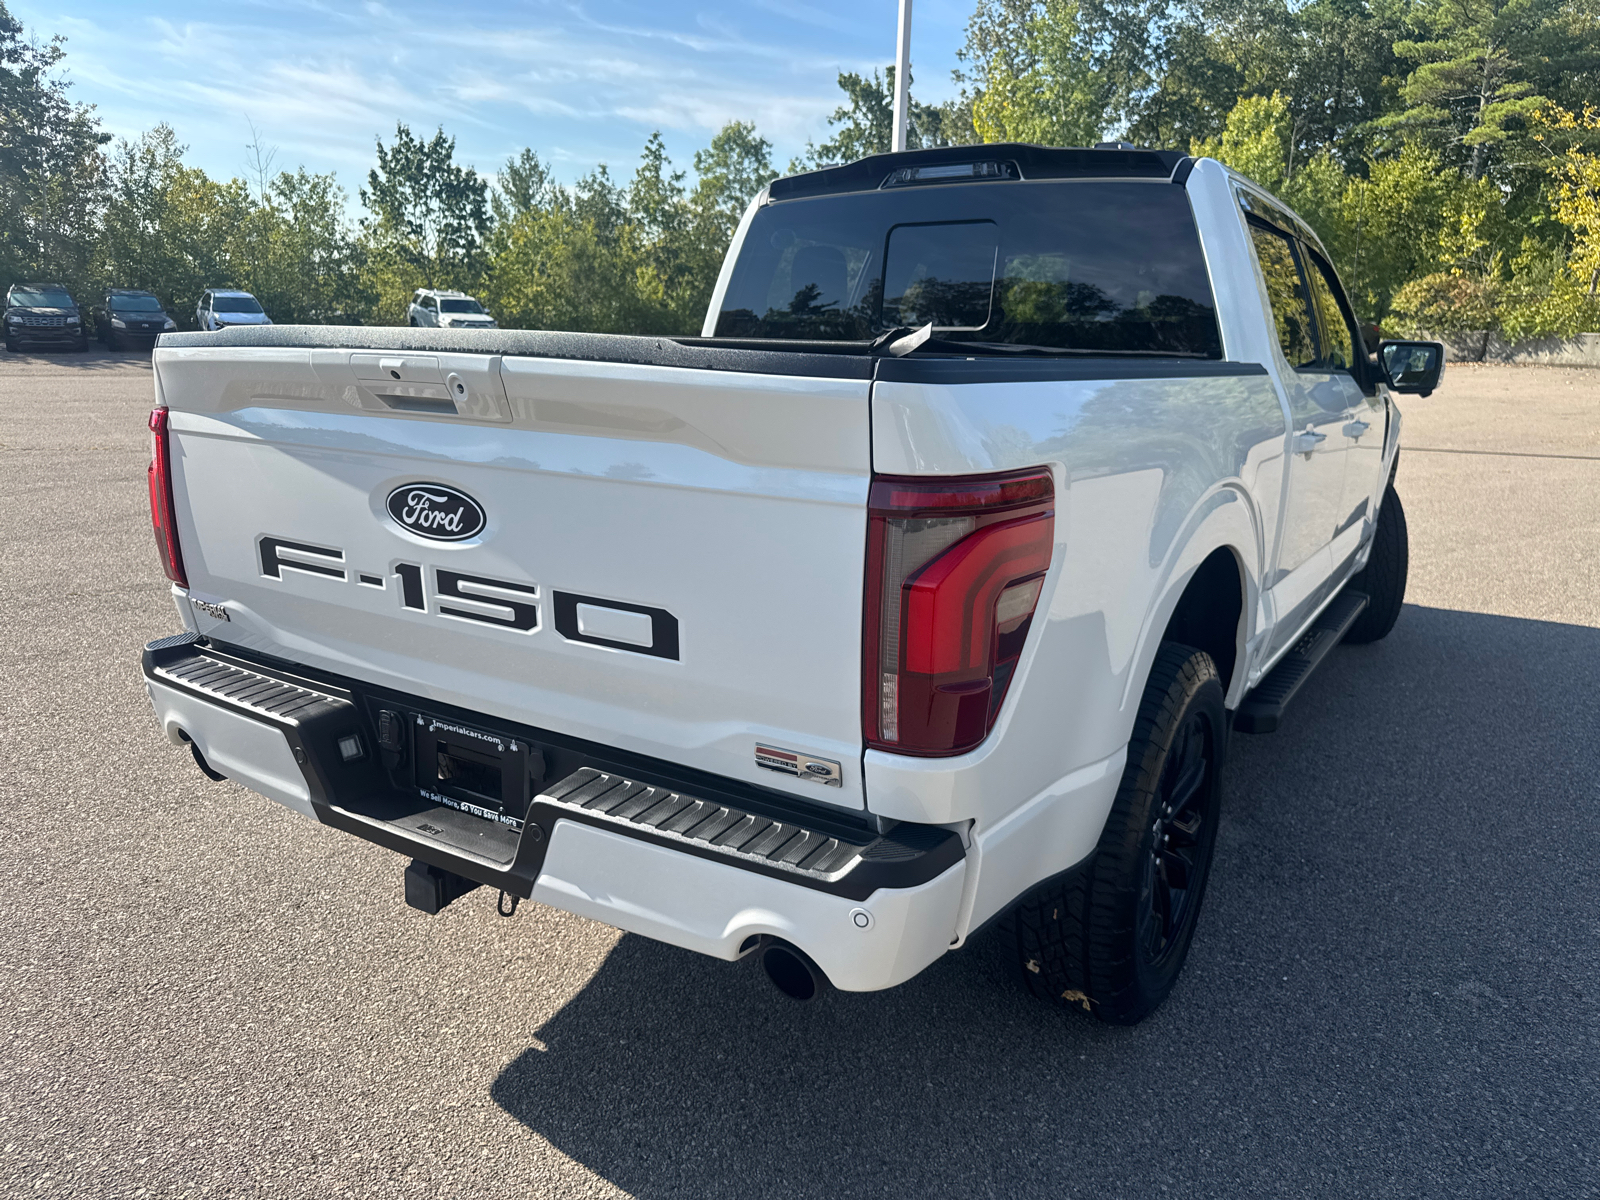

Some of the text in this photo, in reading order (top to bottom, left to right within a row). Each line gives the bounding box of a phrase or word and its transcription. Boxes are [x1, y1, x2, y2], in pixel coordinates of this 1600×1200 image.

[402, 490, 464, 532] Ford
[257, 534, 681, 662] F-150
[432, 719, 501, 744] Imperialcars.com
[420, 789, 517, 827] We Sell More, So You Save More
